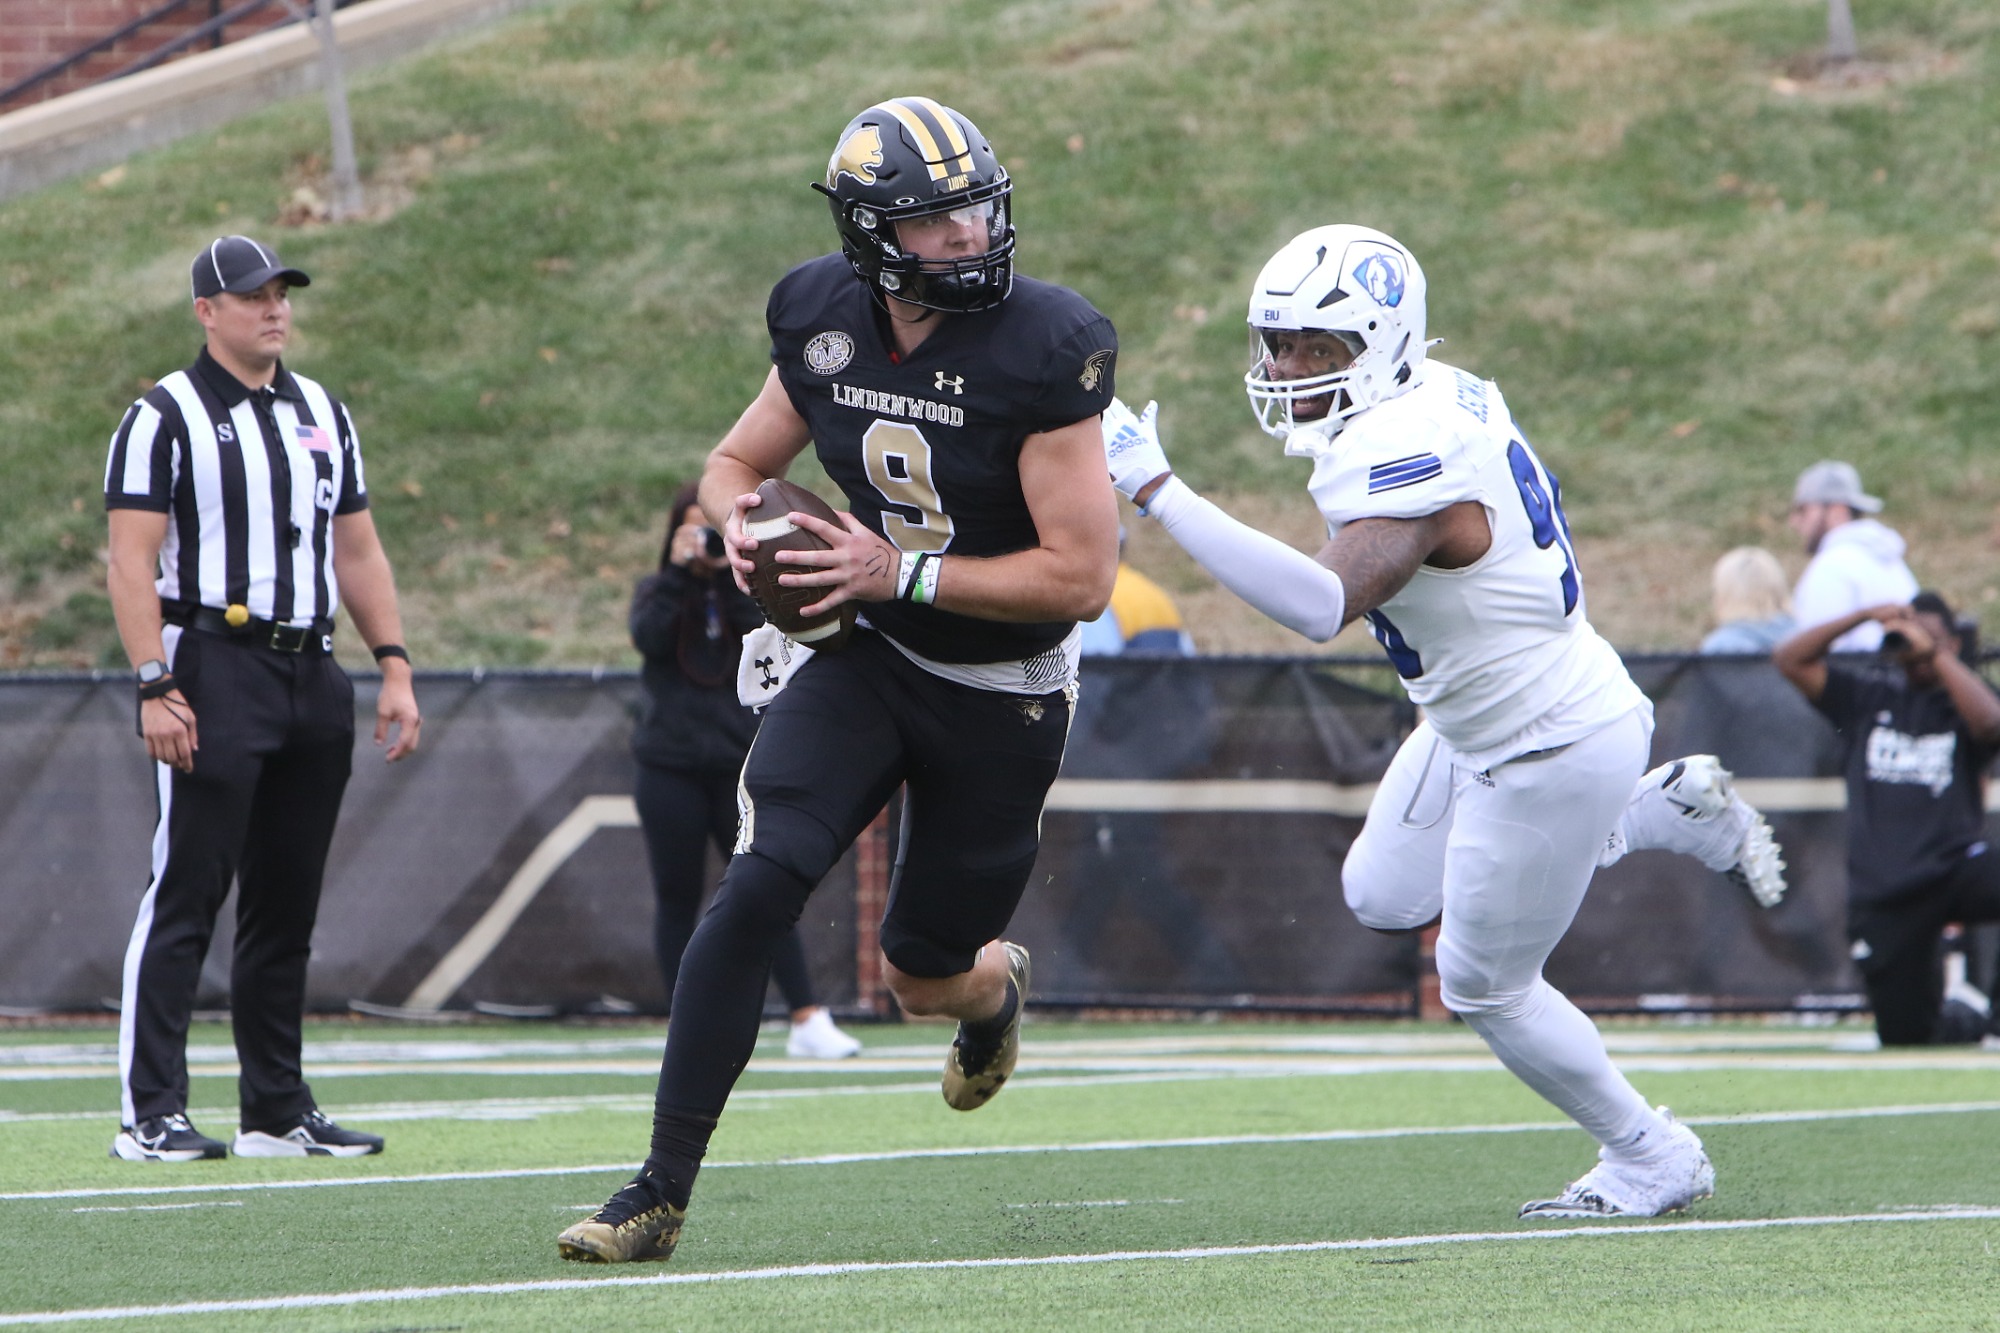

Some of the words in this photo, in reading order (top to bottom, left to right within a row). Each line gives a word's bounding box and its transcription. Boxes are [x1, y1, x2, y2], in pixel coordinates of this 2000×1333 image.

[948, 174, 969, 191] LIONS
[1265, 309, 1279, 321] EIU
[813, 340, 846, 367] OVC
[832, 383, 964, 427] LINDENWOOD
[217, 423, 234, 442] S
[1108, 437, 1149, 458] adidas
[862, 418, 955, 554] 9
